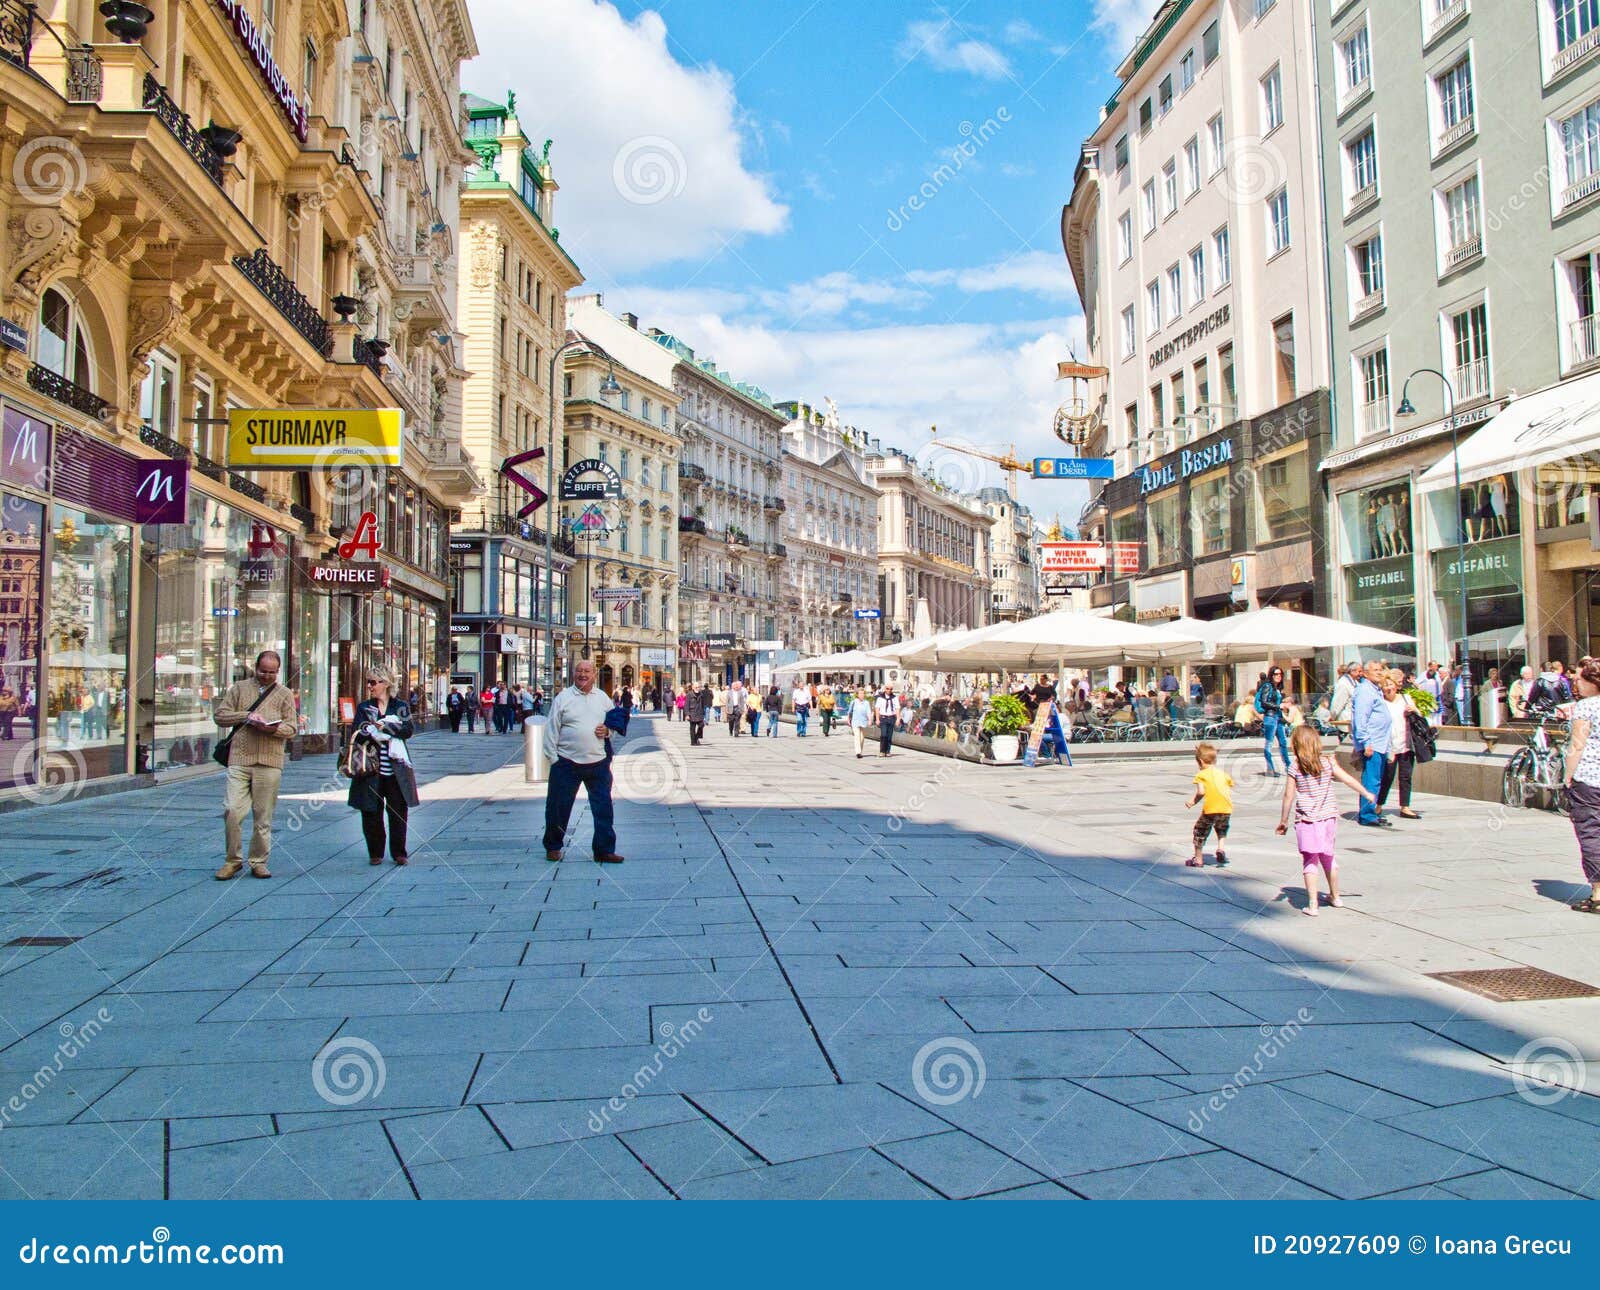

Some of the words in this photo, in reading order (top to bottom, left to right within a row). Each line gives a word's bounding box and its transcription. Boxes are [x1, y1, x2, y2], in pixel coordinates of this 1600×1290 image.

[1149, 303, 1231, 370] ORIENTTEPPICHE
[246, 419, 347, 446] STURMAYR
[1140, 463, 1177, 496] ADIL
[1181, 438, 1233, 478] BESIM
[574, 483, 607, 491] BUFFET
[313, 566, 376, 583] APOTHEKE
[1449, 554, 1509, 575] STEFANEL
[1358, 571, 1406, 588] STEFANEL
